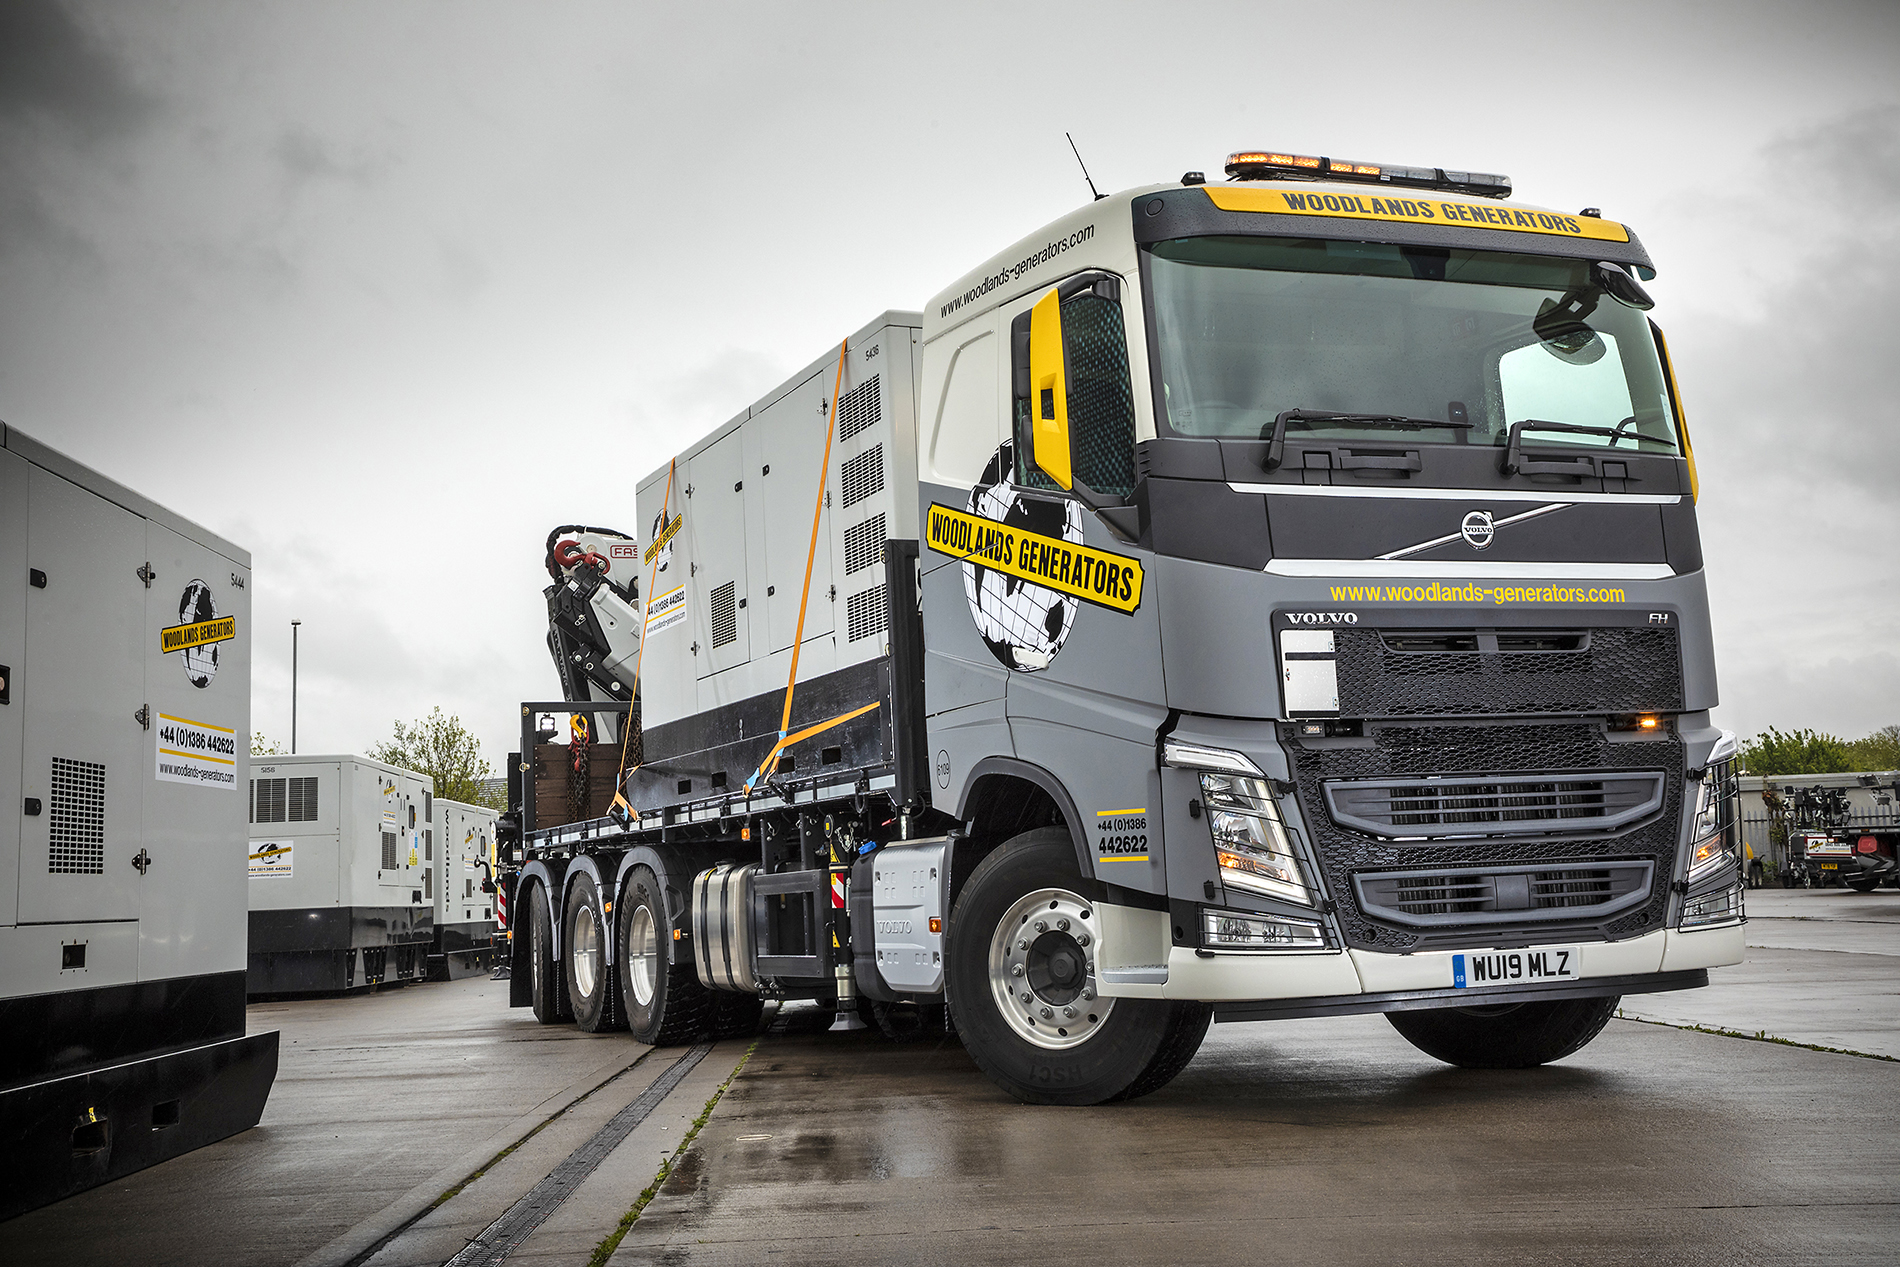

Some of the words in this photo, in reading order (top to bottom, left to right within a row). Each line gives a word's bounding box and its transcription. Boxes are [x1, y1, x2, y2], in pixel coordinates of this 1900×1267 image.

[1282, 193, 1435, 218] WOODLANDS
[1441, 203, 1581, 234] GENERATORS
[940, 224, 1095, 318] www.woodlands-generators.com
[865, 344, 880, 361] 5436
[932, 512, 1015, 566] WOODLANDS
[1019, 538, 1135, 602] GENERATORS
[231, 572, 245, 591] 5444
[1330, 582, 1626, 605] www.woodlands-generators.com
[1285, 612, 1358, 625] VOLVO
[1648, 612, 1670, 625] FH
[163, 627, 198, 648] WOODLANDS
[200, 620, 234, 641] GENERATORS
[160, 726, 175, 744] +44
[176, 727, 206, 750] (0)1386
[207, 735, 235, 755] 442622
[159, 763, 235, 784] www.woodlands-generators.com
[1097, 820, 1113, 832] +44
[1114, 817, 1147, 832] (0)1386
[1099, 834, 1148, 854] 442622
[876, 919, 913, 935] VOLVO
[1472, 954, 1522, 981] WU19
[1527, 951, 1571, 978] MLZ
